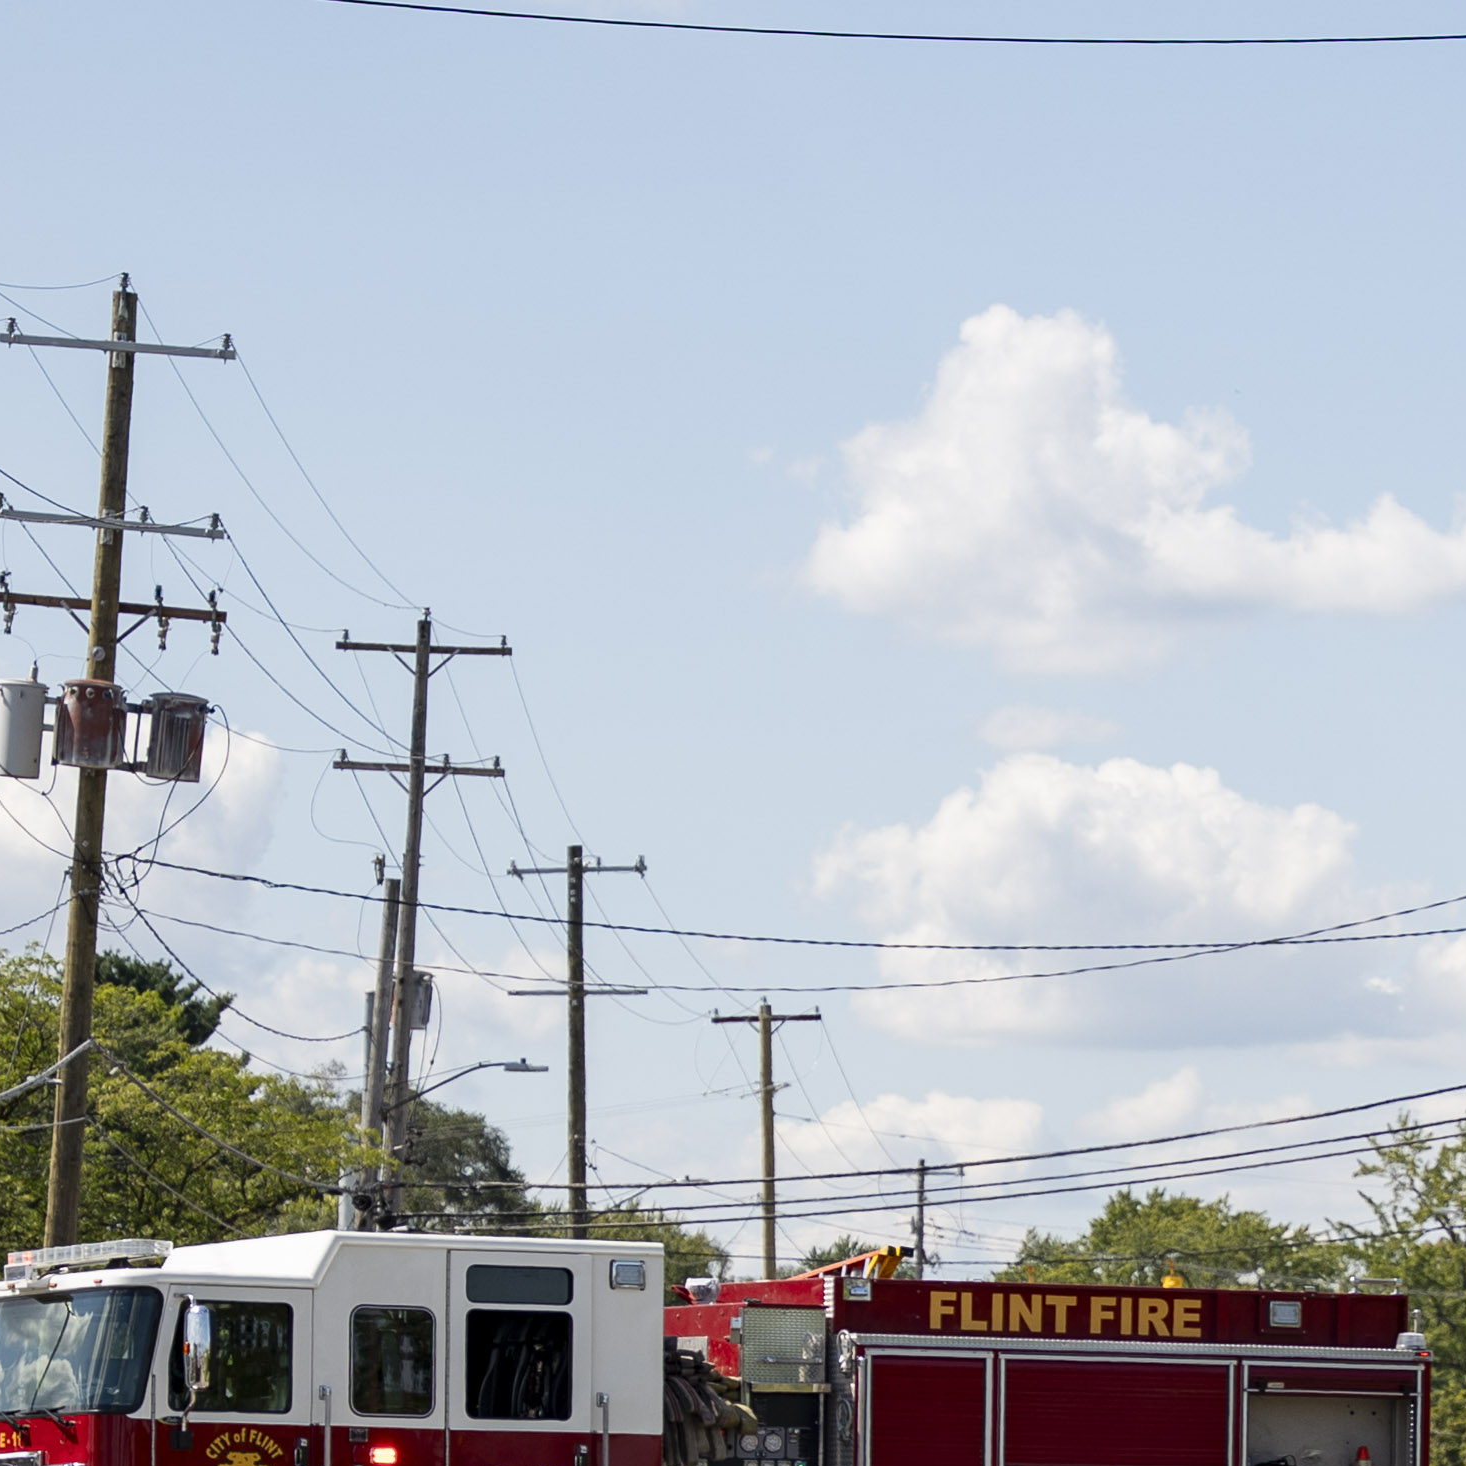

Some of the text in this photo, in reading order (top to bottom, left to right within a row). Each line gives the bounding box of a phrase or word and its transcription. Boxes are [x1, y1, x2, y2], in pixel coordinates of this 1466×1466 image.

[929, 1290, 1203, 1338] FLINT FIRE
[205, 1427, 284, 1459] CITY of FLINT
